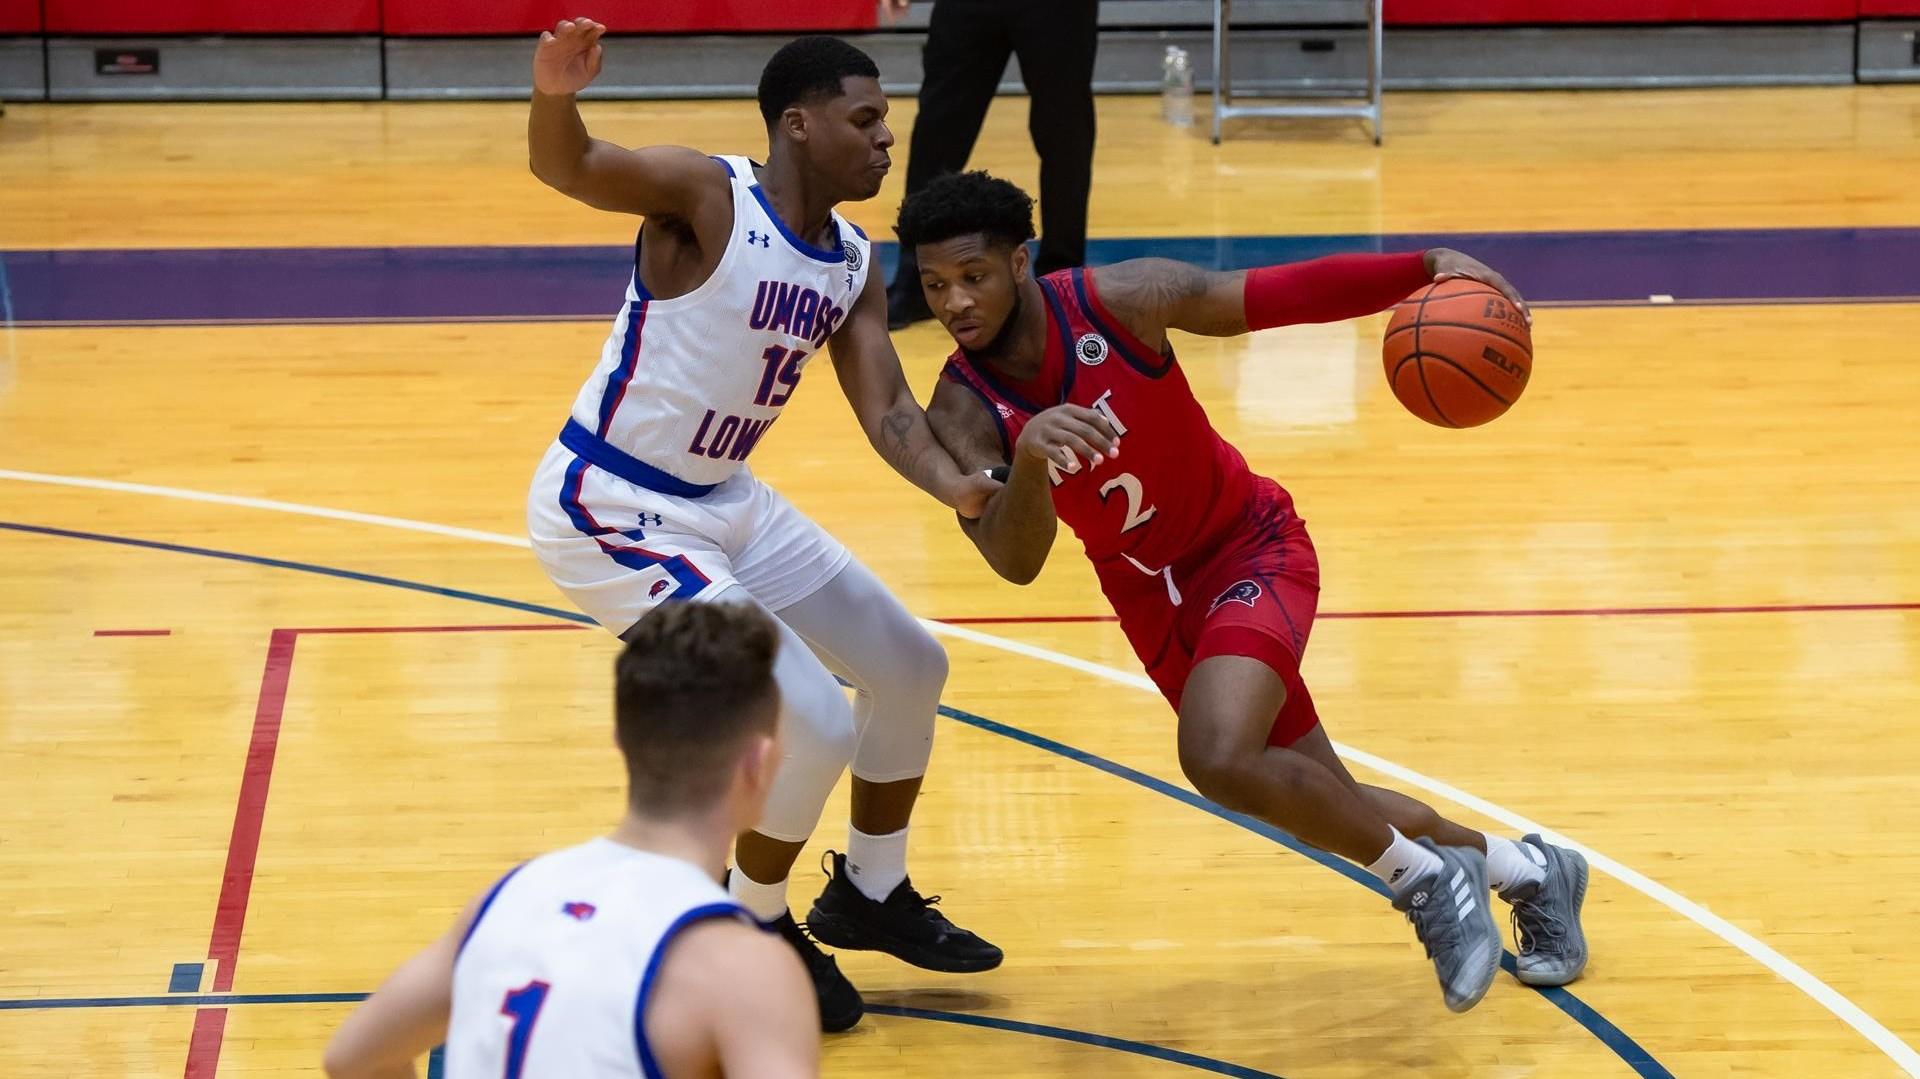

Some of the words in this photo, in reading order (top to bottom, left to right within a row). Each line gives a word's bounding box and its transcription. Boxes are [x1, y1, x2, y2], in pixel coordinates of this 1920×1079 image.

[749, 280, 844, 350] UMASS
[753, 343, 808, 407] 15
[1099, 472, 1157, 534] 2
[499, 979, 551, 1079] 1
